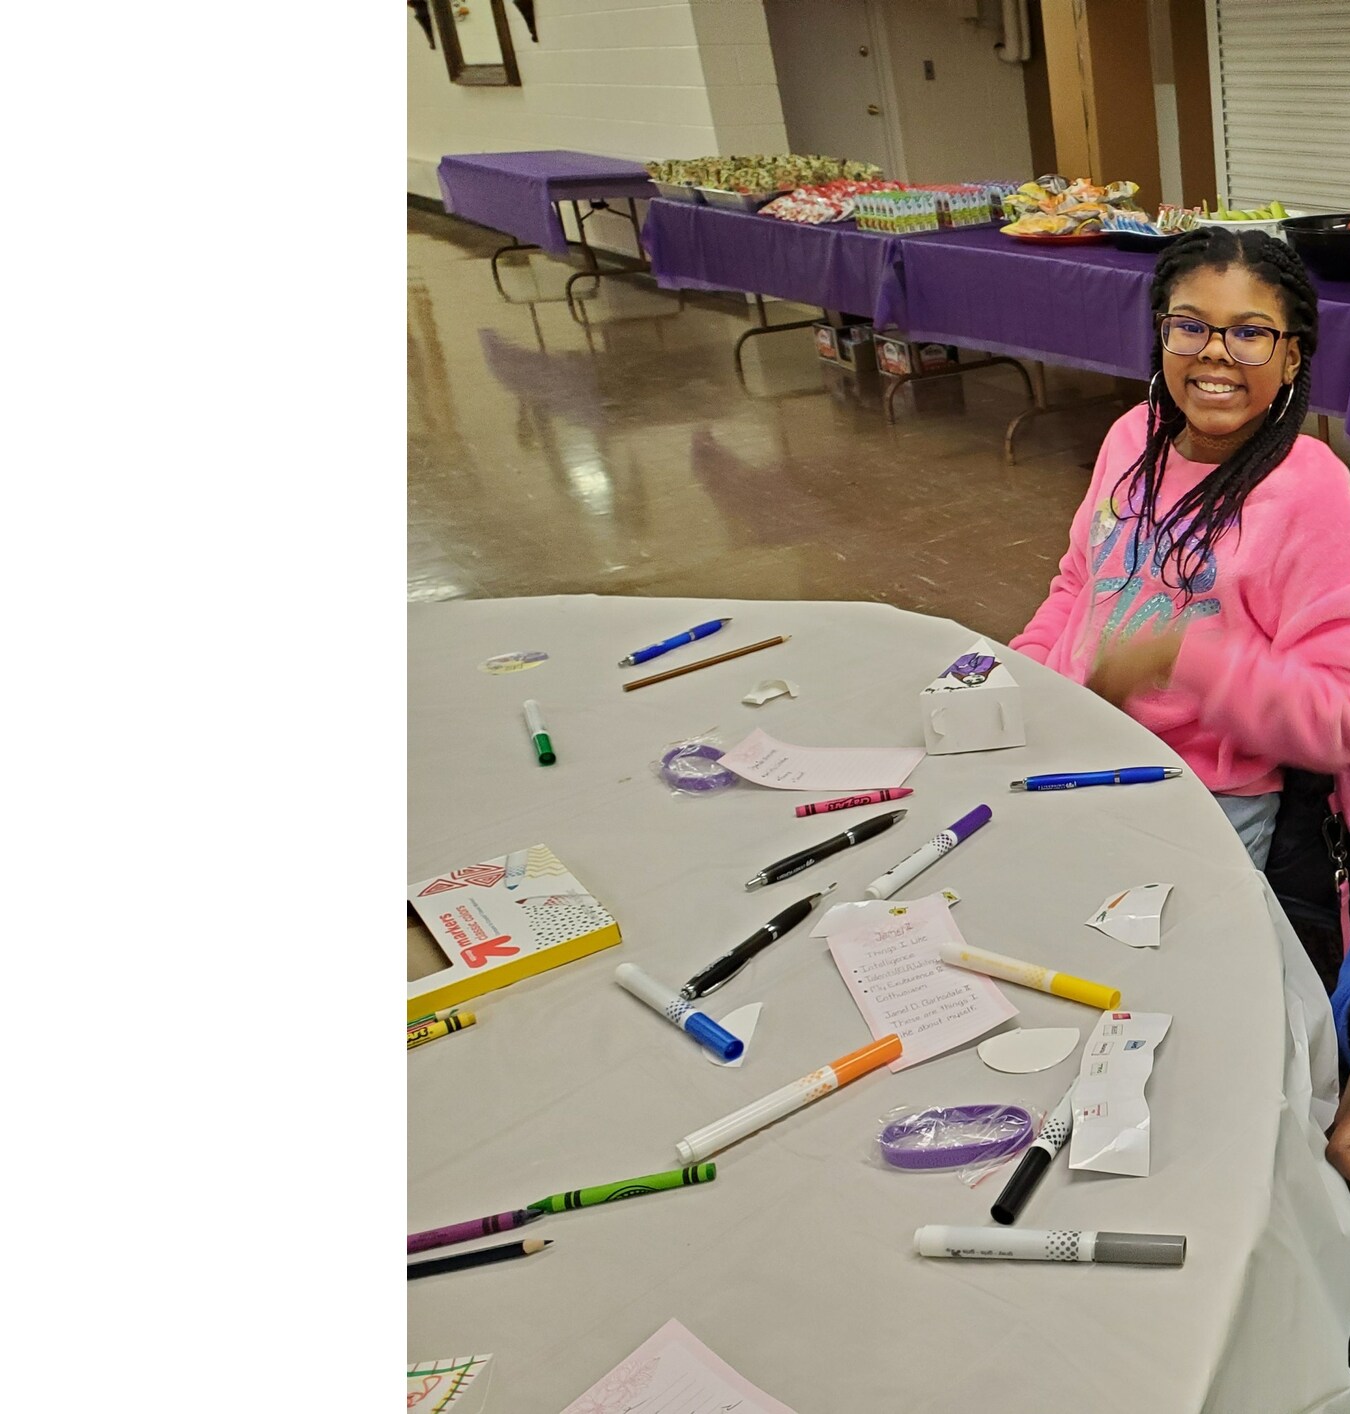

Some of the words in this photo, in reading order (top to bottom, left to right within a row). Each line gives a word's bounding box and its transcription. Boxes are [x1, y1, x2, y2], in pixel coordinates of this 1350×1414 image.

[456, 906, 474, 922] colors
[440, 913, 472, 947] markers
[468, 922, 488, 940] classic
[867, 946, 897, 958] Things
[860, 953, 915, 973] Intelligence
[884, 1005, 909, 1019] Jamel
[924, 1009, 937, 1018] are
[940, 999, 968, 1013] things
[918, 1018, 943, 1032] about
